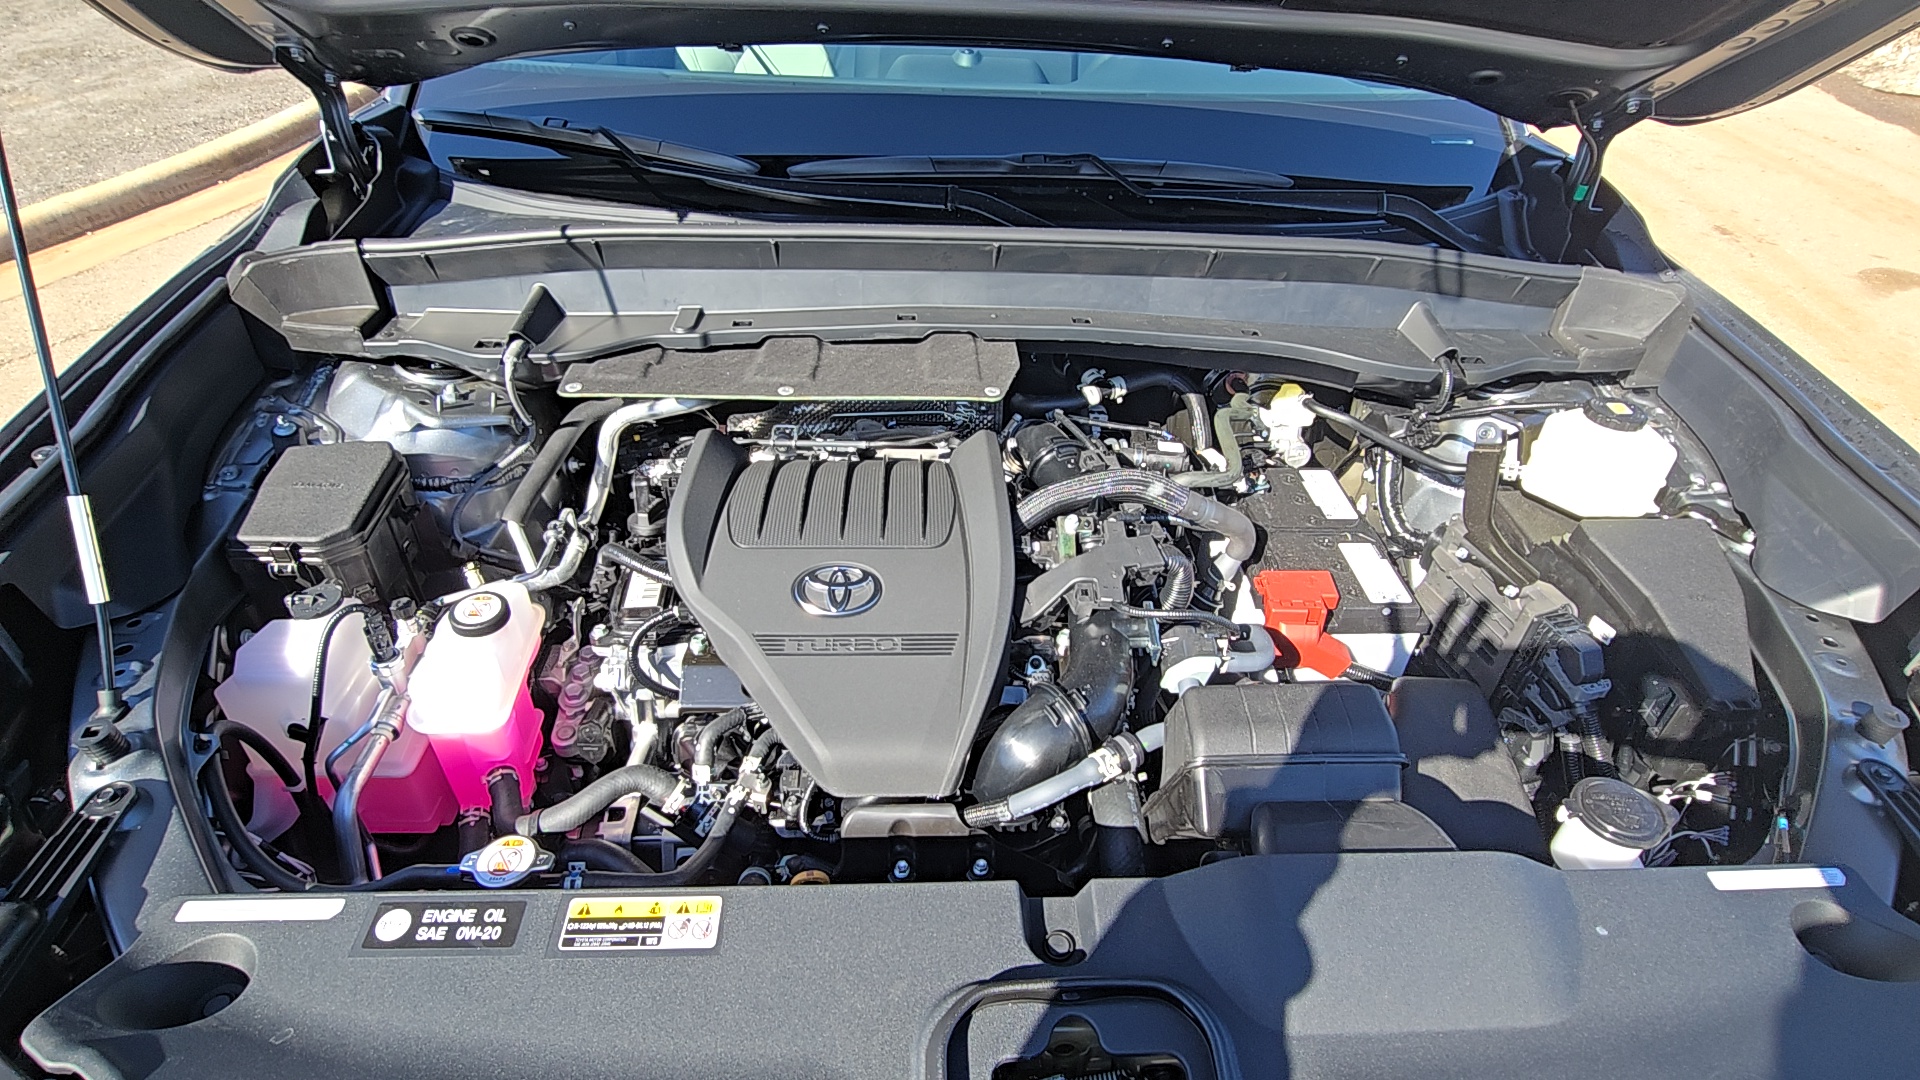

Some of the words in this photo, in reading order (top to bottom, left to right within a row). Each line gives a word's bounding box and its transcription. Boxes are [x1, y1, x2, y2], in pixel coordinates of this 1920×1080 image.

[788, 637, 899, 652] TURBO
[421, 908, 477, 923] ENGINE
[483, 908, 507, 923] OIL
[415, 926, 448, 941] SAE
[455, 925, 502, 940] 0W-20
